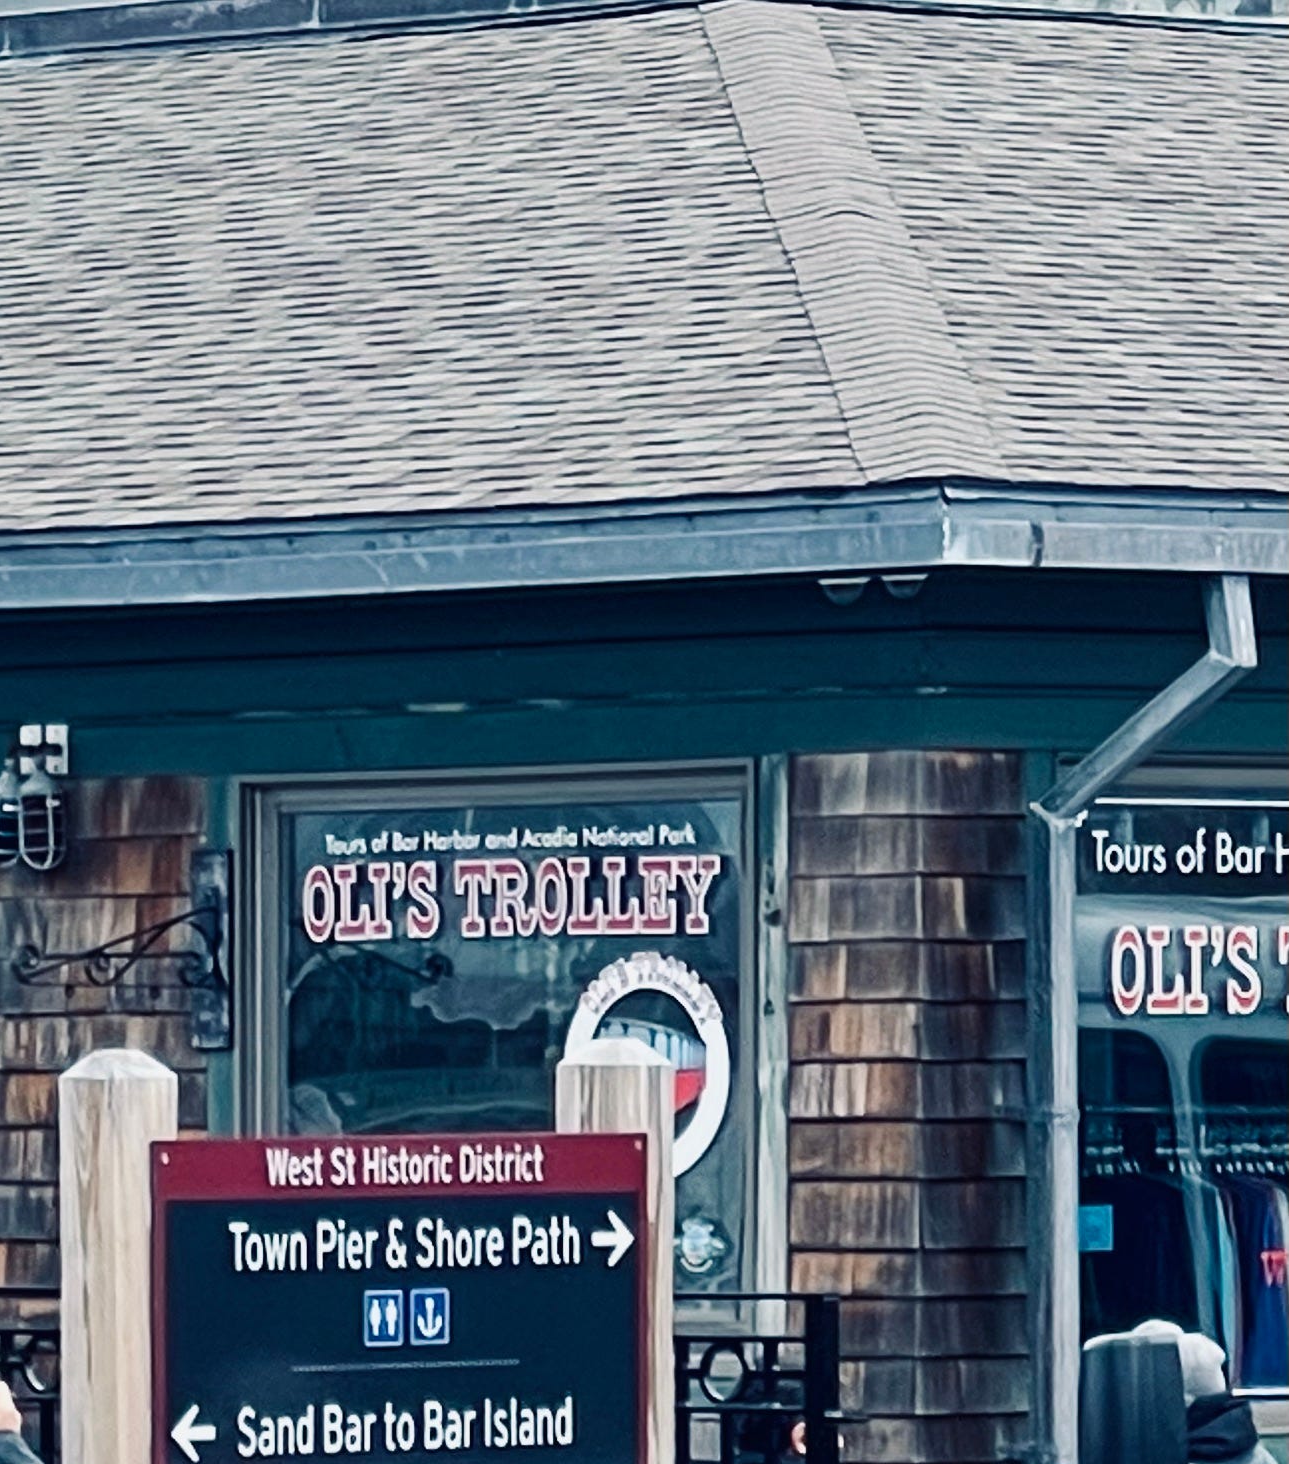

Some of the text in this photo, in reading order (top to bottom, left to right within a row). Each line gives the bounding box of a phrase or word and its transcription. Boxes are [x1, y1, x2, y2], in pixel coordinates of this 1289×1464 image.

[325, 821, 696, 856] Tours of Bar Harbor and Acadia National Park
[1091, 829, 1166, 874] Tours
[1175, 827, 1206, 873] of
[1215, 830, 1266, 873] Bar
[303, 854, 721, 943] OLI'S TROLLEY
[1111, 924, 1262, 1016] OLI'S
[265, 1143, 545, 1187] West St Historic District
[227, 1214, 582, 1272] Town Pier & Shore Path
[236, 1396, 574, 1458] Sand Bar to Bar Island
